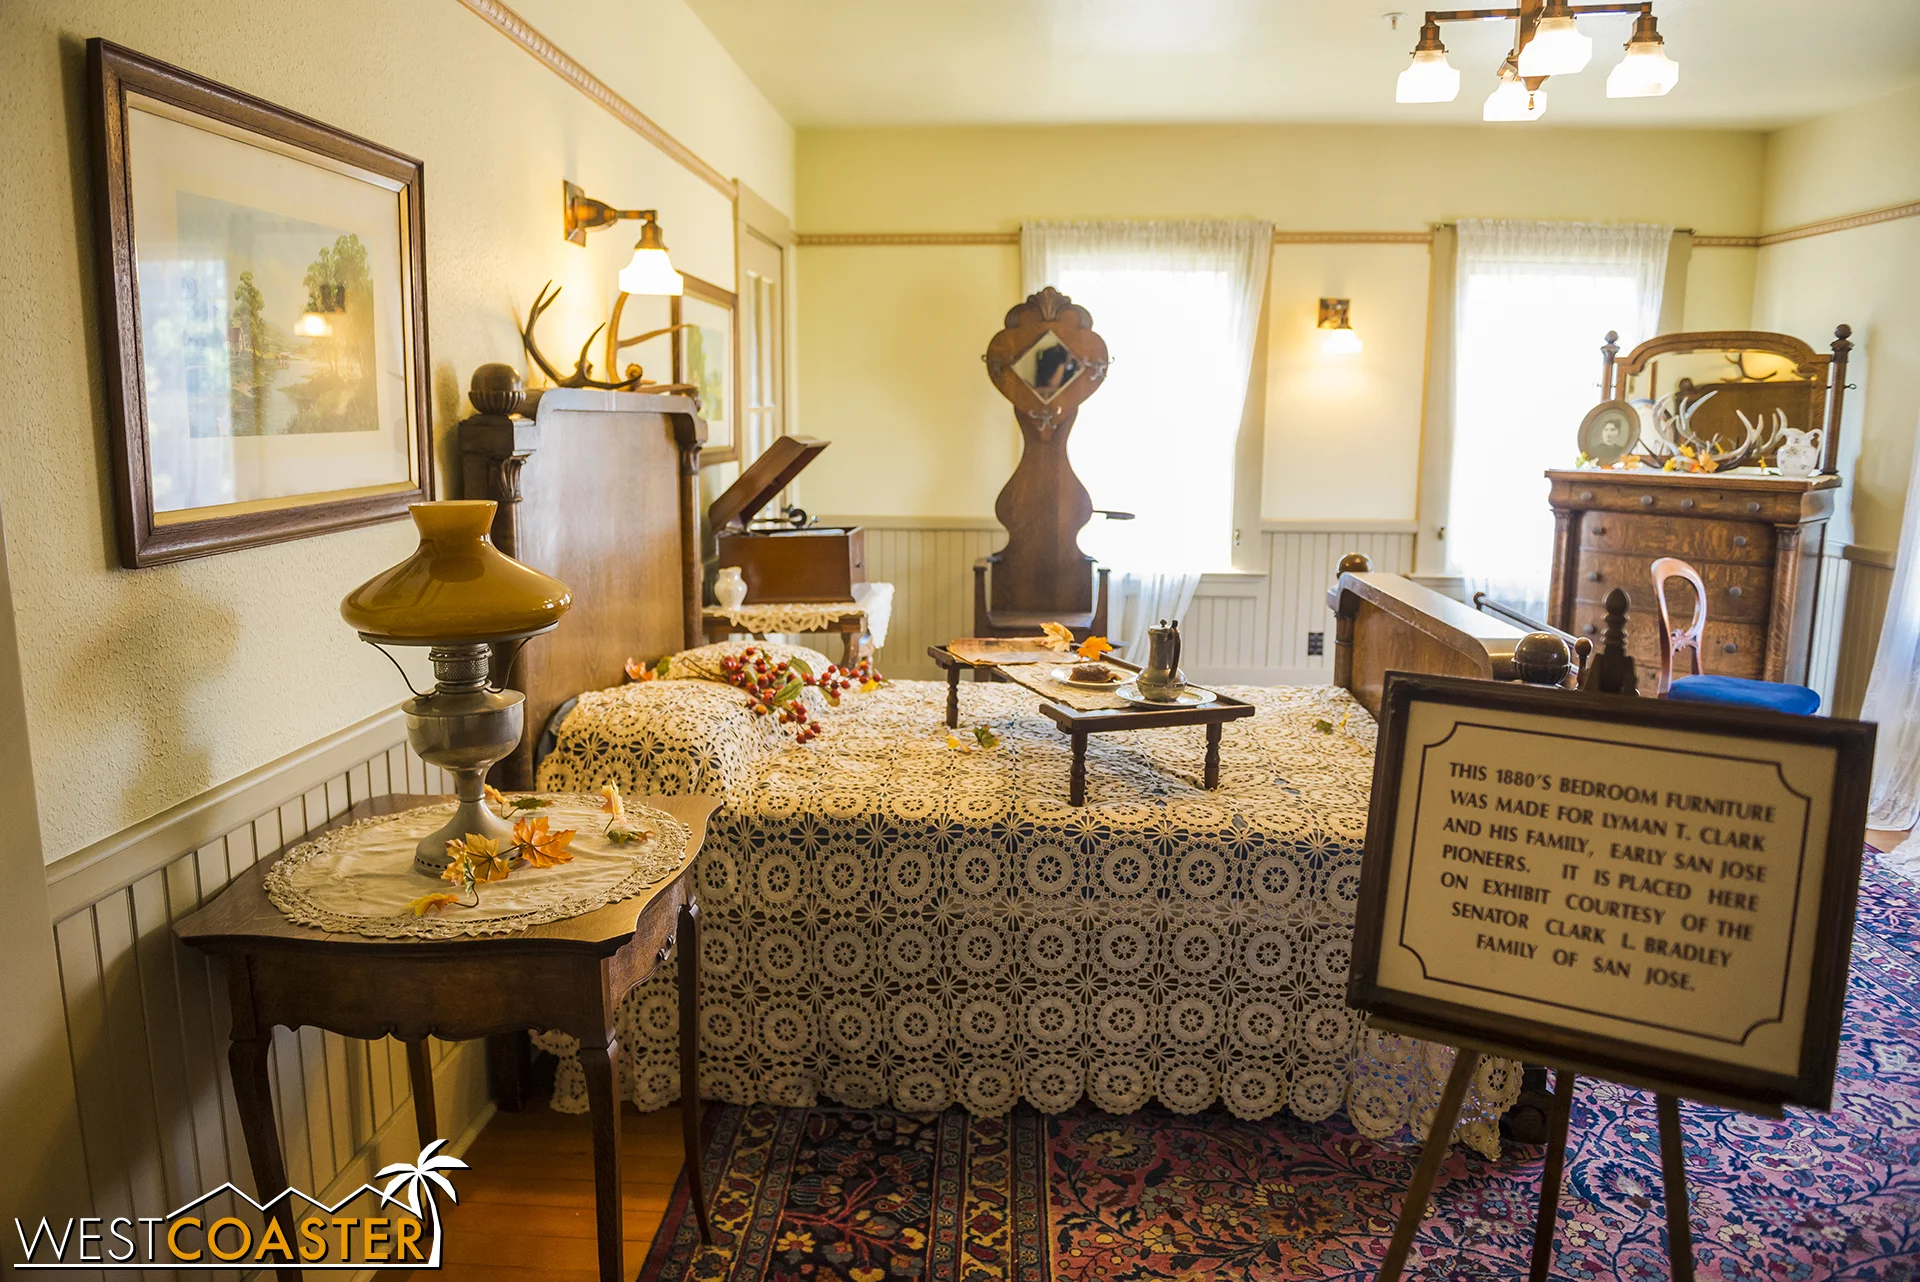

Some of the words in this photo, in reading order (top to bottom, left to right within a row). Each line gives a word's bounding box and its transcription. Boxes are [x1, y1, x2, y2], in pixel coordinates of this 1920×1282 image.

[1449, 762, 1488, 782] THIS
[1496, 769, 1553, 791] 1880'S
[1559, 776, 1659, 806] BEDROOM
[1664, 792, 1776, 824] FURNITURE
[1449, 790, 1489, 810] WAS
[1495, 799, 1551, 819] MADE
[1557, 806, 1594, 826] FOR
[1601, 813, 1667, 837] LYMAN
[1675, 822, 1692, 841] T.
[1700, 827, 1765, 852] CLARK
[1442, 844, 1532, 874] PIONEERS.
[1562, 864, 1580, 880] IT
[1594, 870, 1611, 886] IS
[1618, 874, 1692, 900] PLACED
[1708, 889, 1758, 912] HERE
[1443, 817, 1482, 836] AND
[1489, 824, 1519, 842] HIS
[1526, 830, 1596, 857] FAMILY,
[1609, 843, 1666, 866] EARLY
[1674, 853, 1714, 874] SAN
[1720, 860, 1767, 883] JOSE
[1440, 872, 1470, 890] ON
[1483, 879, 1552, 904] EXHIBIT
[1565, 893, 1666, 926] COURTESY
[1681, 914, 1709, 932] OF
[1718, 921, 1754, 941] THE
[1452, 902, 1529, 929] SENATOR
[1544, 919, 1606, 944] CLARK
[1621, 933, 1637, 950] L.
[1644, 938, 1733, 968] BRADLEY
[1477, 934, 1539, 960] FAMILY
[1553, 949, 1578, 967] OF
[1594, 957, 1630, 978] SAN
[1645, 967, 1696, 991] JOSE.
